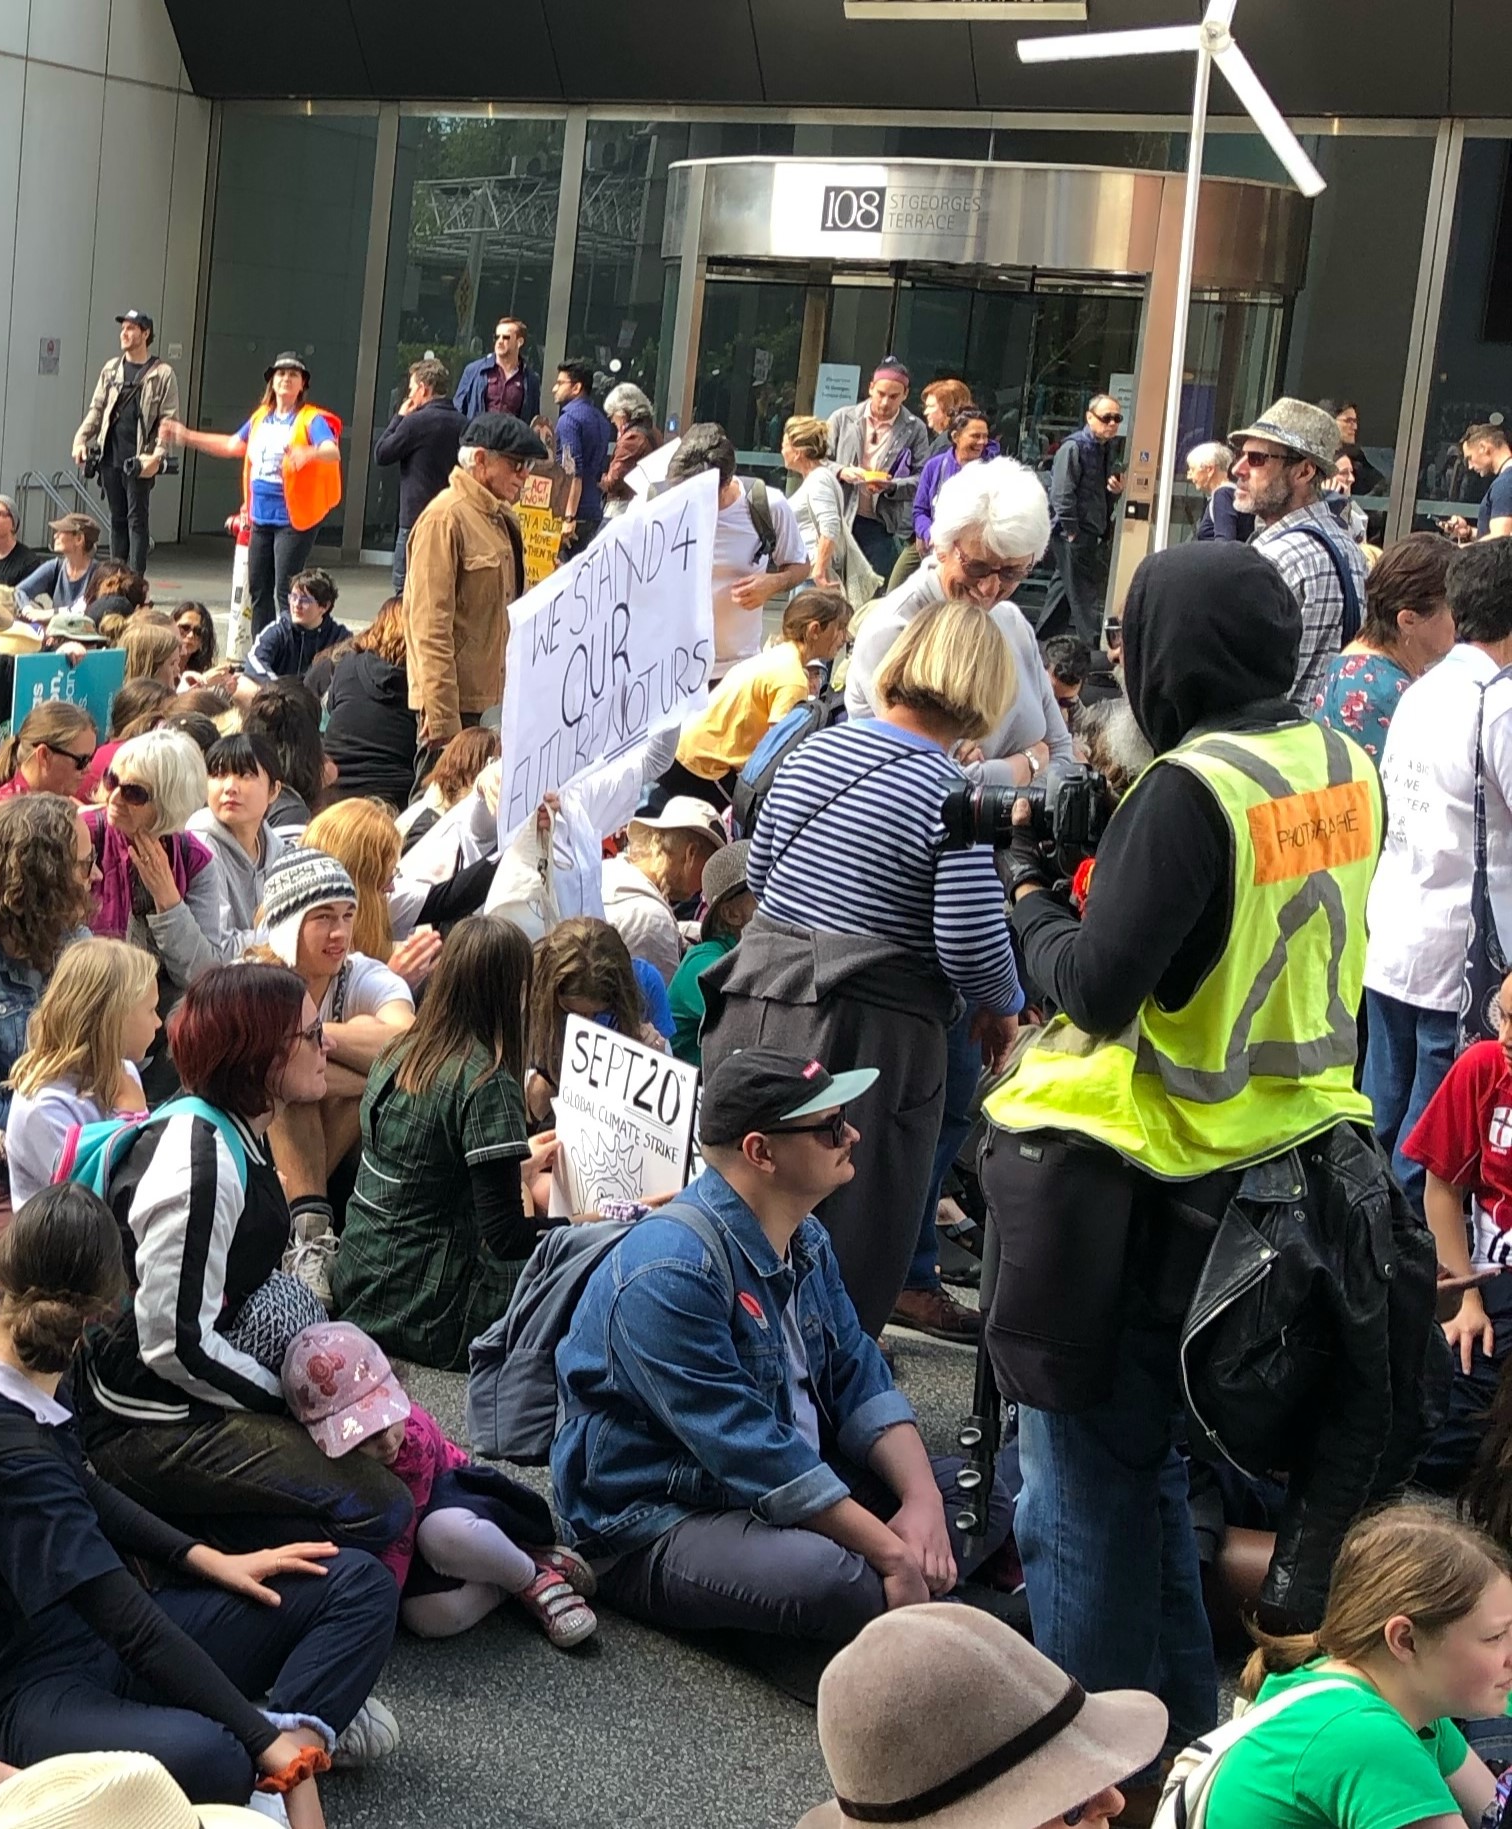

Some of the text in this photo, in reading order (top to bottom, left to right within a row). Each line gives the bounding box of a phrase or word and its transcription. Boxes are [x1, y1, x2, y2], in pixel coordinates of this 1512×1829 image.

[825, 189, 881, 229] 108
[889, 212, 955, 231] TERRACE
[530, 479, 549, 494] ACT
[531, 500, 697, 667] WE STAND 4
[561, 602, 631, 727] OUR
[507, 697, 605, 833] FUTURE
[571, 1030, 644, 1101] SEPT
[562, 1086, 680, 1165] GLOBAL CLIMATE STRIKE
